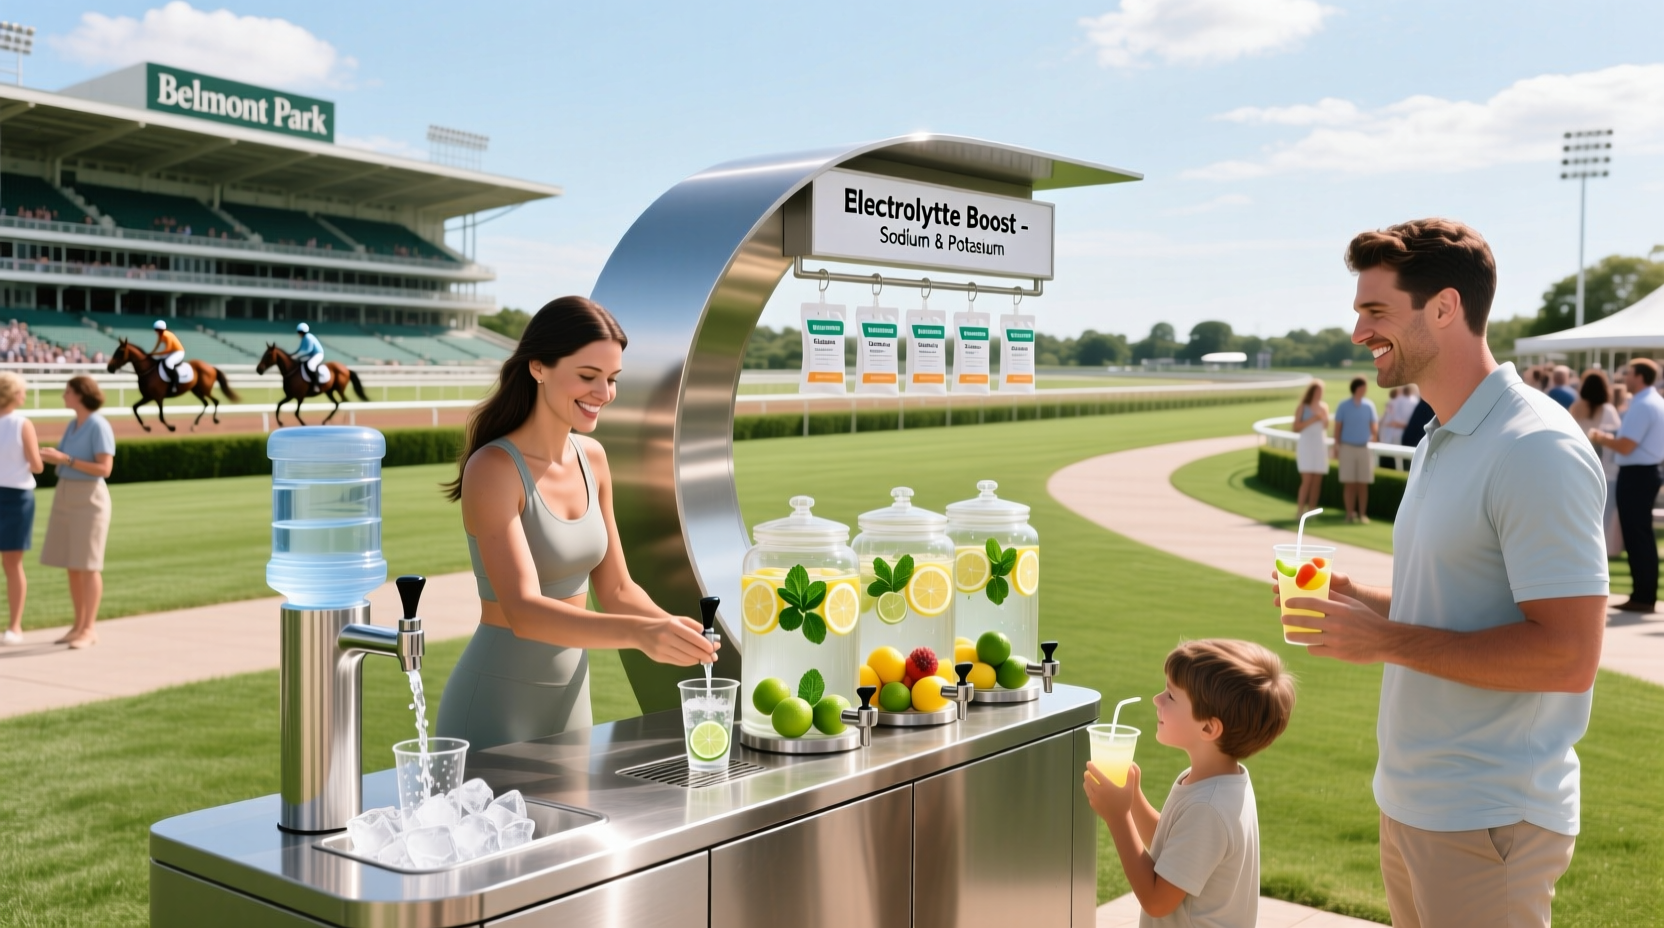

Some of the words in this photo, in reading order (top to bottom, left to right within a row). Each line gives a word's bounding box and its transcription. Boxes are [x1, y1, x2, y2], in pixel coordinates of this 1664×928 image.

[157, 72, 268, 124] Belmont
[273, 96, 328, 136] Park
[844, 187, 961, 229] Electrolytte
[966, 205, 1017, 234] Boost
[879, 226, 930, 248] Sodium
[935, 233, 944, 249] &
[948, 234, 1005, 256] Potasium
